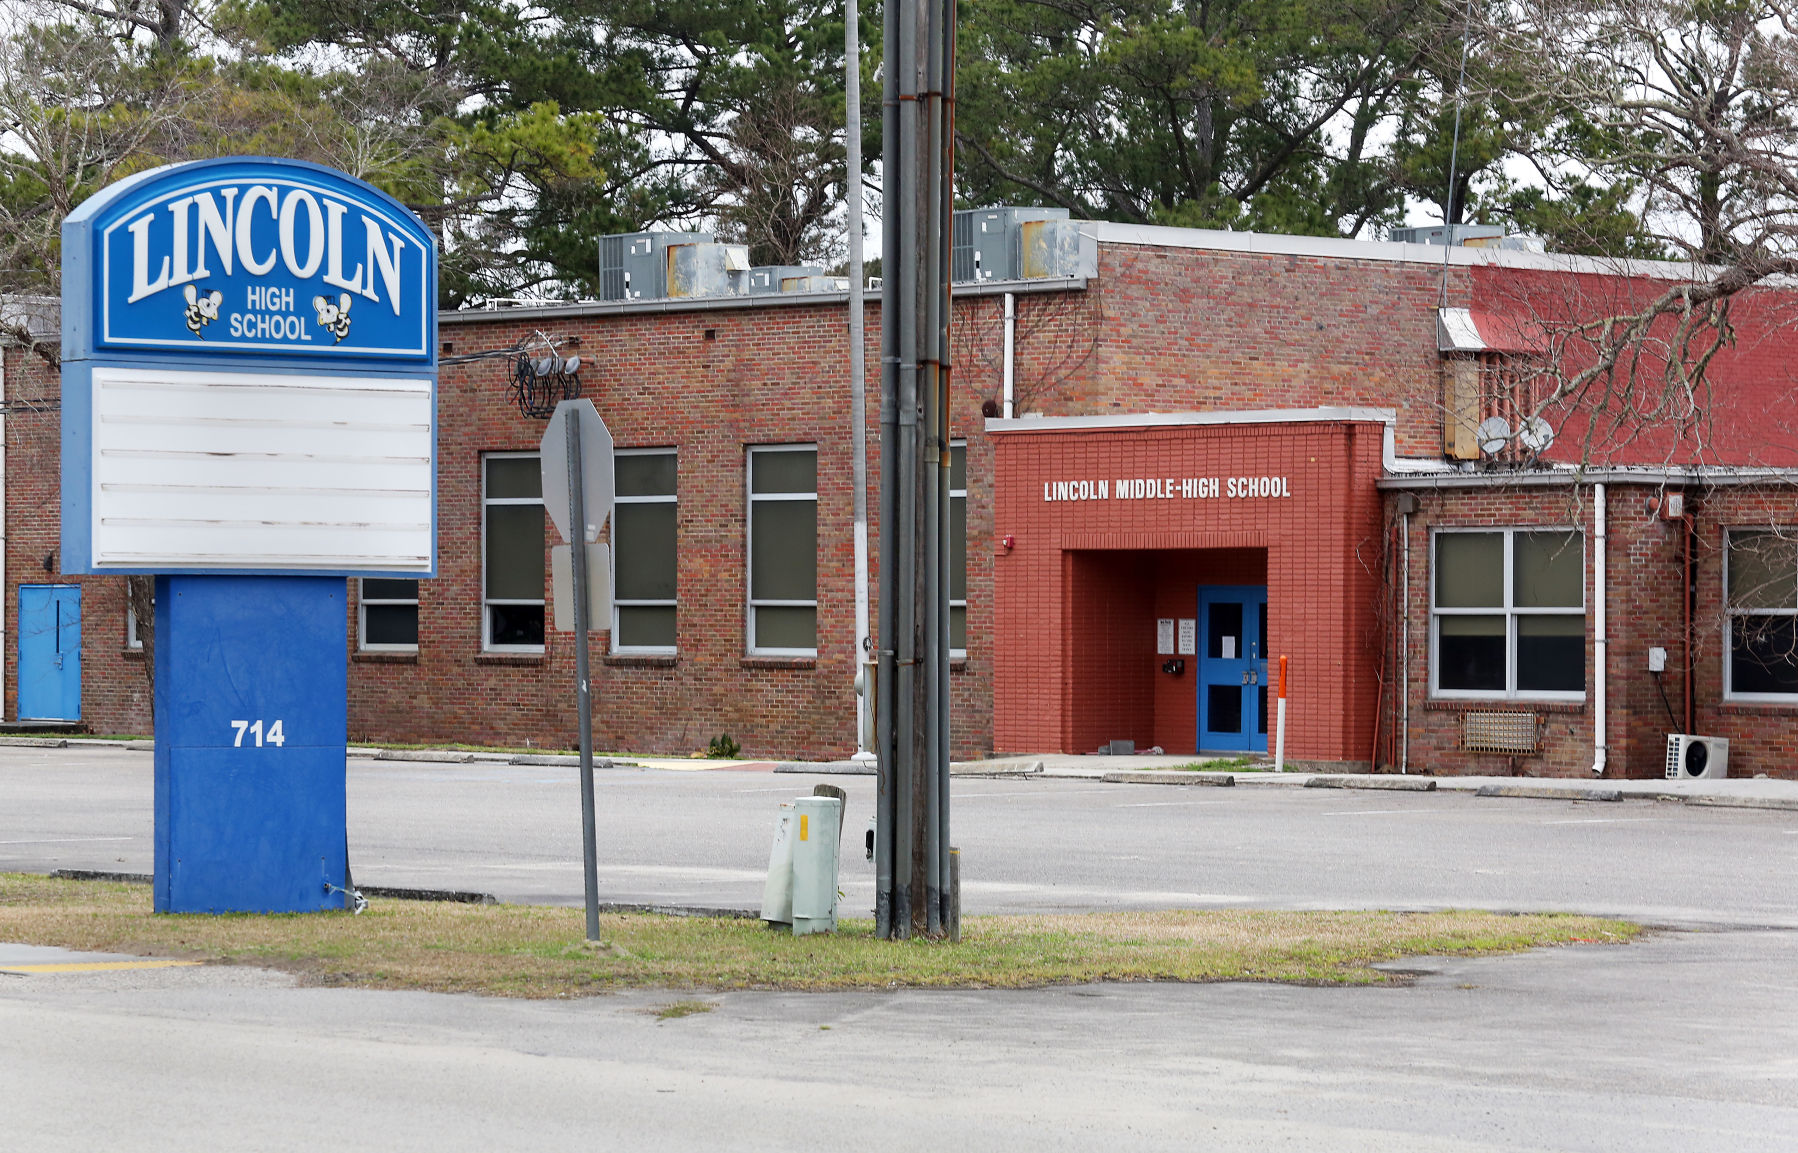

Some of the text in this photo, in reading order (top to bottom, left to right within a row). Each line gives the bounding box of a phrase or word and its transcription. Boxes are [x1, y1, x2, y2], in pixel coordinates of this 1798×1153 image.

[128, 185, 405, 316] LINCOLN
[247, 285, 295, 312] HIGH
[229, 312, 312, 341] SCHOOL
[1043, 476, 1291, 502] LINCOLN MIDDLE-HIGH SCHOOL
[230, 719, 285, 748] 714
